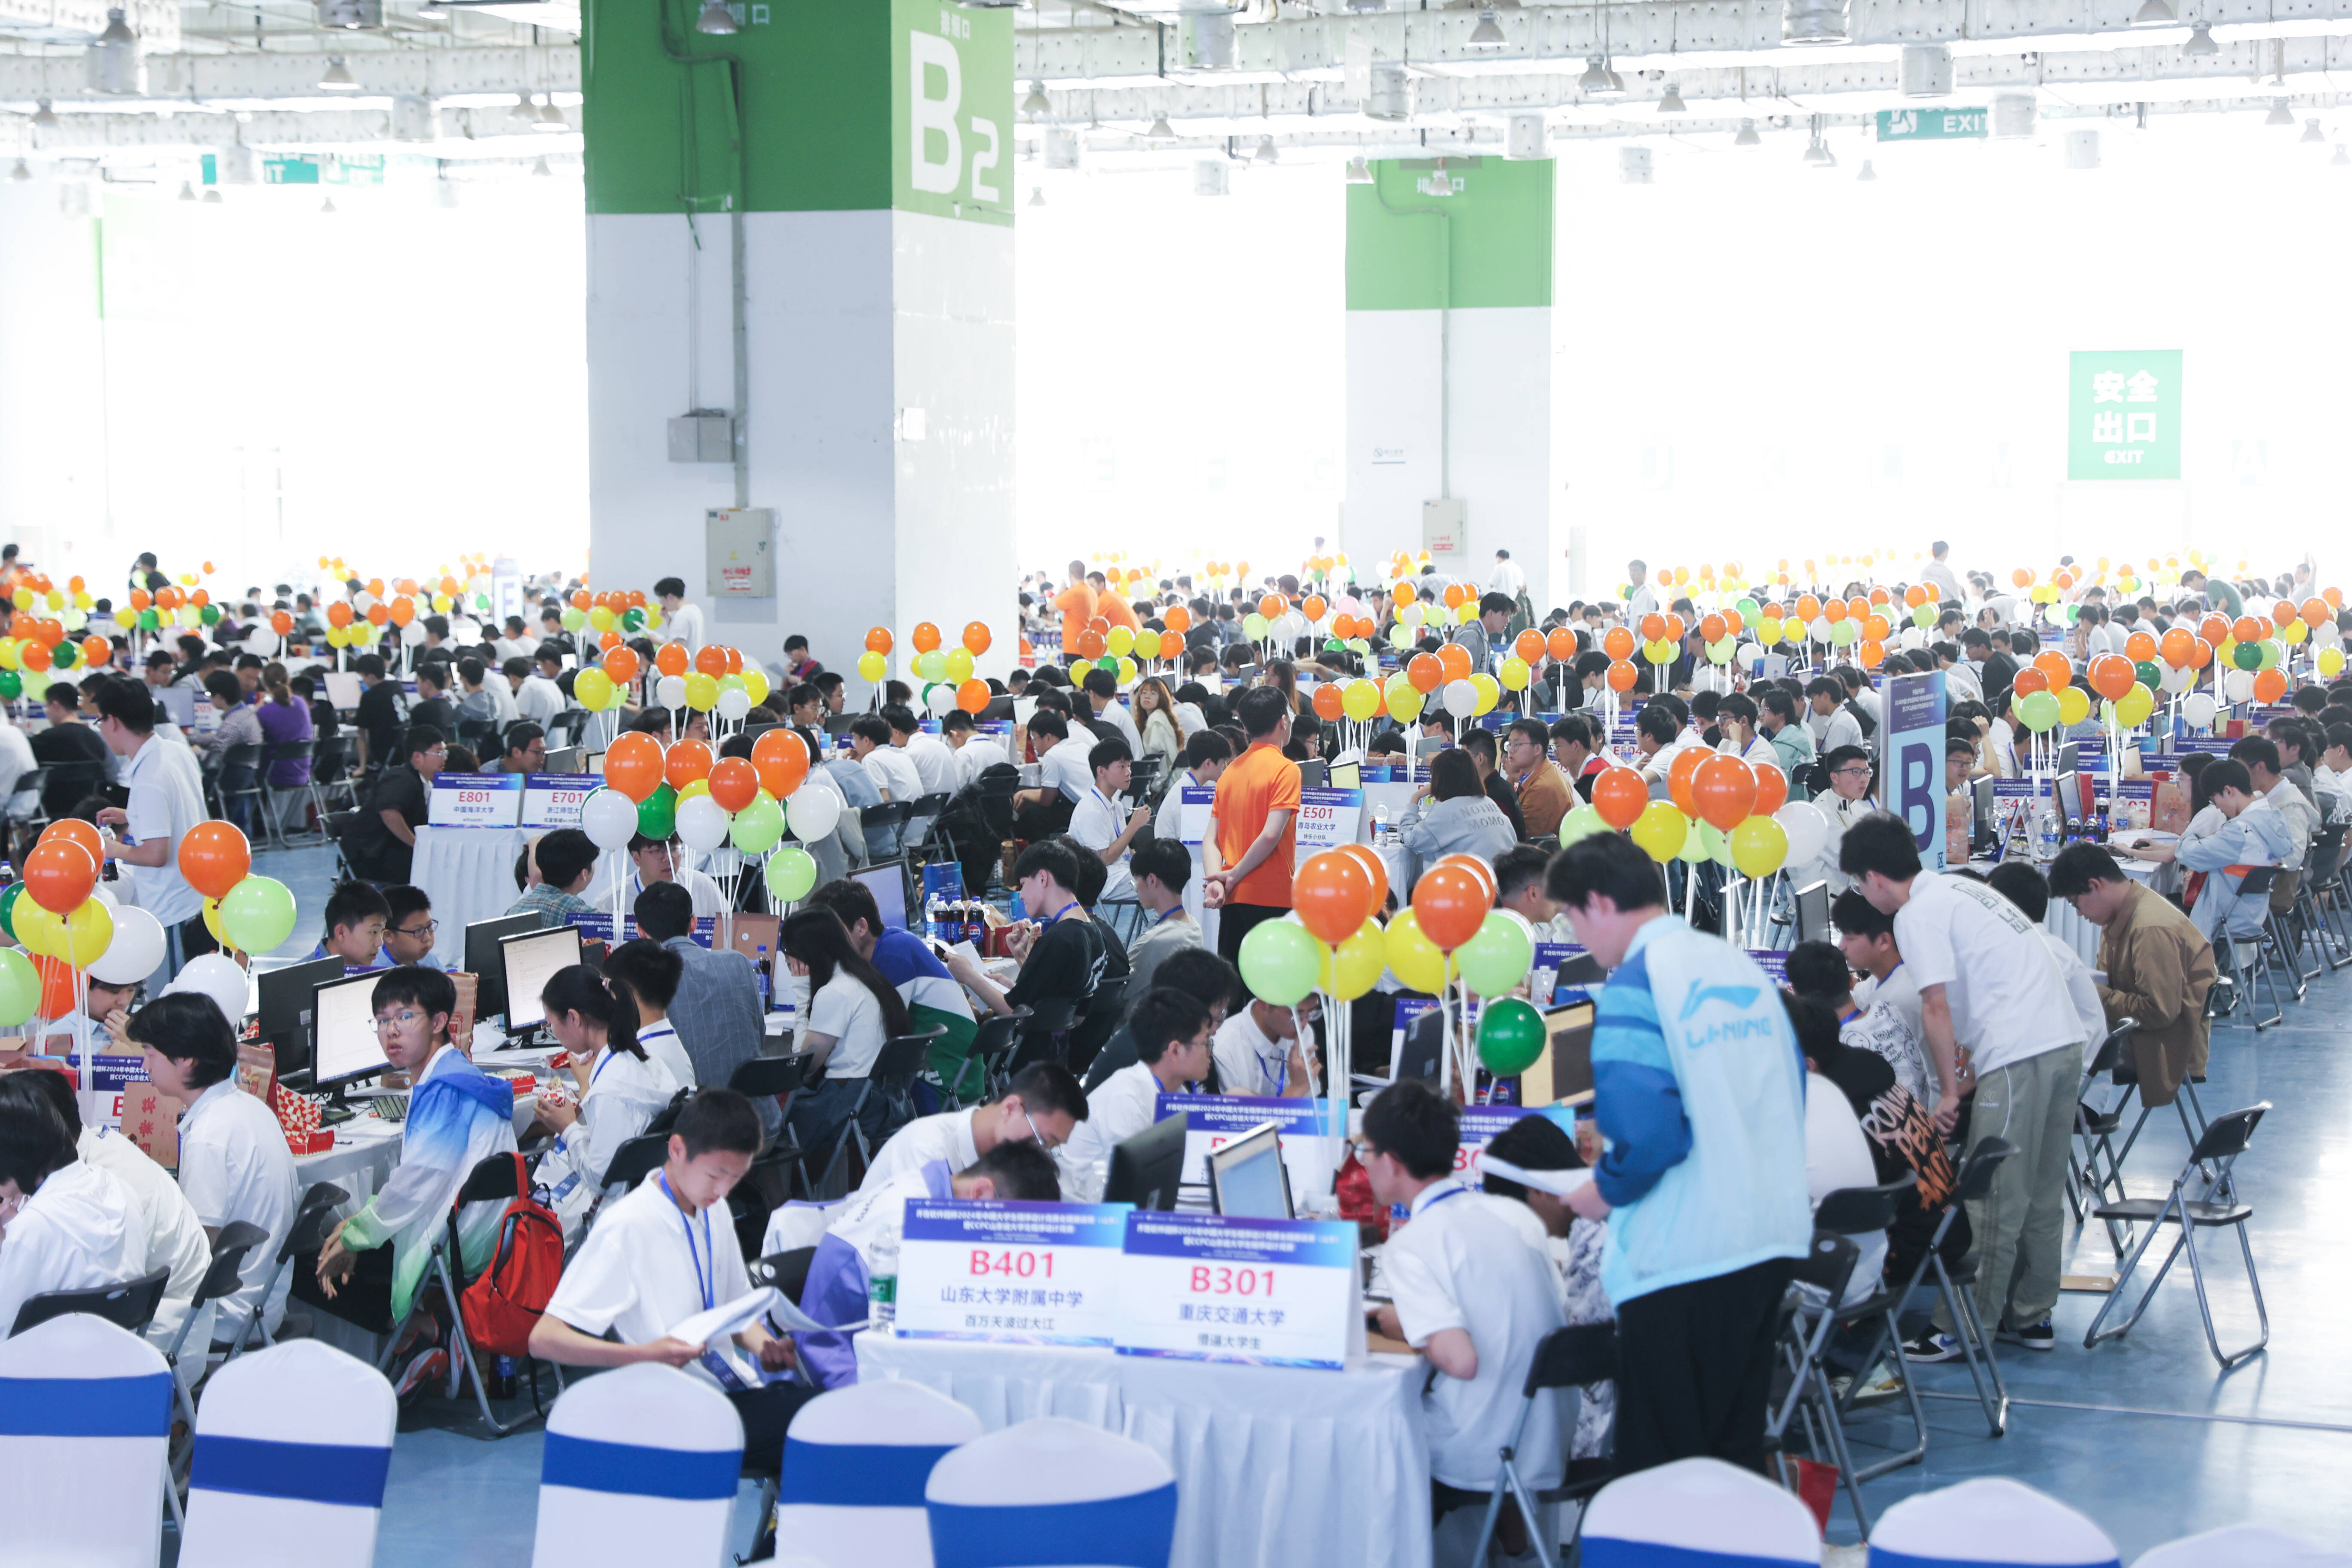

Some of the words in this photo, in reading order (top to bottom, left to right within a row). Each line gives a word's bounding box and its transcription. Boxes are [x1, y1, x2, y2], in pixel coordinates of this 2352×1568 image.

[1416, 177, 1465, 194] 排口
[2092, 370, 2159, 403] 安全
[2092, 410, 2156, 444] 出口
[2104, 450, 2144, 463] EXIT
[459, 791, 490, 802] E801
[552, 793, 583, 803] E701
[1901, 743, 1935, 853] B
[546, 806, 580, 814] 浙江师范大
[1304, 806, 1333, 819] E501
[1298, 821, 1336, 831] 青岛农业大学
[110, 1073, 153, 1082] 暨CCPC山东省大
[970, 1250, 1054, 1278] B401
[1190, 1266, 1276, 1297] B301
[940, 1285, 1084, 1308] 山东大学附属中学
[1178, 1303, 1286, 1327] 重庆交通大学
